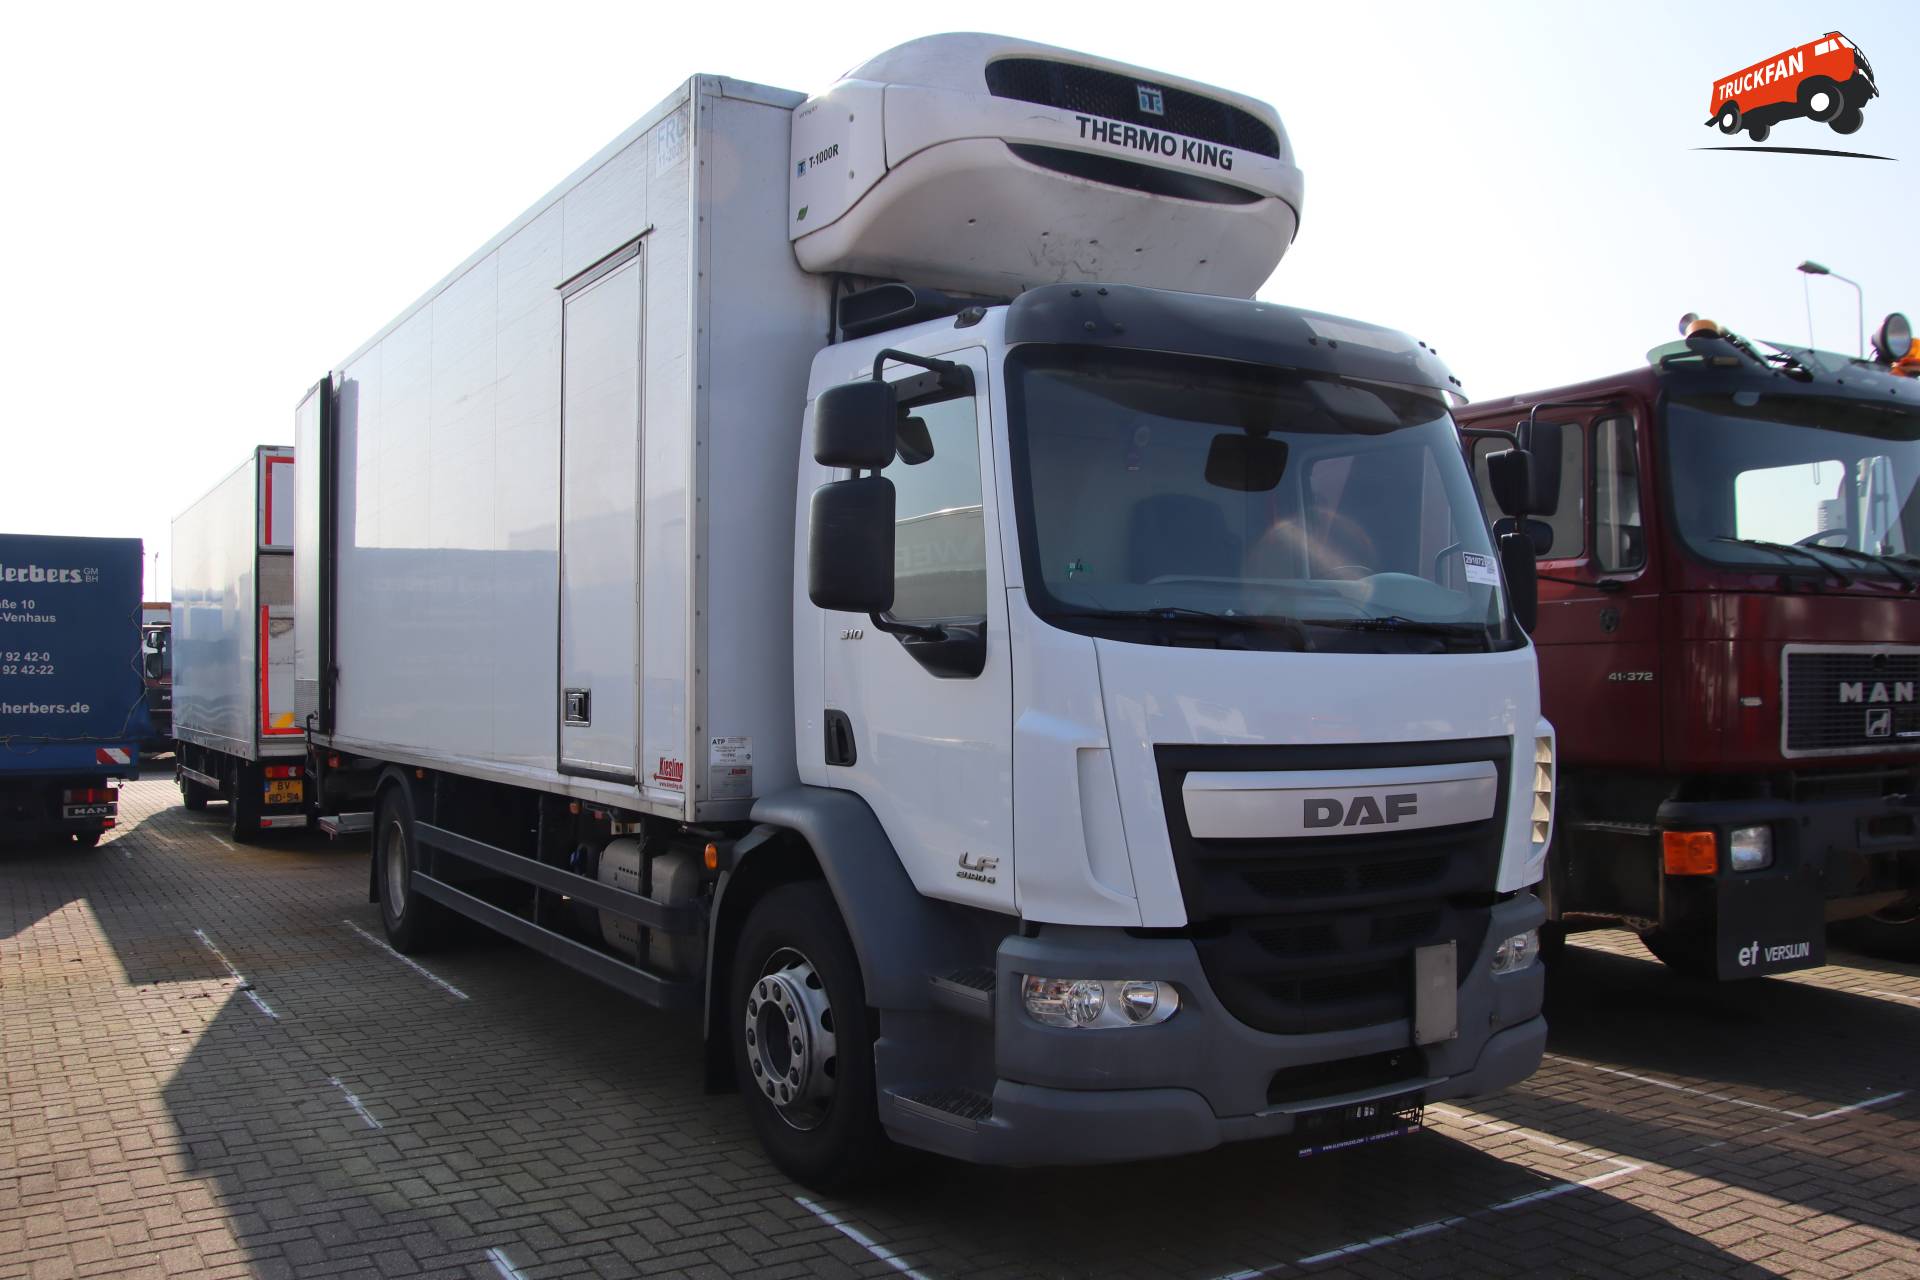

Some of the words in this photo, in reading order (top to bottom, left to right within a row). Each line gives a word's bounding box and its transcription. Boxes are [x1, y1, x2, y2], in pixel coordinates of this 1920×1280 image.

[1076, 115, 1177, 157] THERMO
[1181, 139, 1233, 171] KING
[808, 143, 839, 169] T-1000R
[0, 599, 17, 609] ße
[21, 599, 36, 609] 10
[5, 651, 21, 662] 92
[23, 651, 51, 662] 42-0
[2, 664, 18, 675] 92
[20, 664, 55, 675] 42-22
[1839, 681, 1914, 703] MAN
[659, 757, 684, 778] Kiesling
[74, 807, 108, 815] MAN
[1303, 793, 1418, 829] DAF
[958, 851, 999, 872] LF
